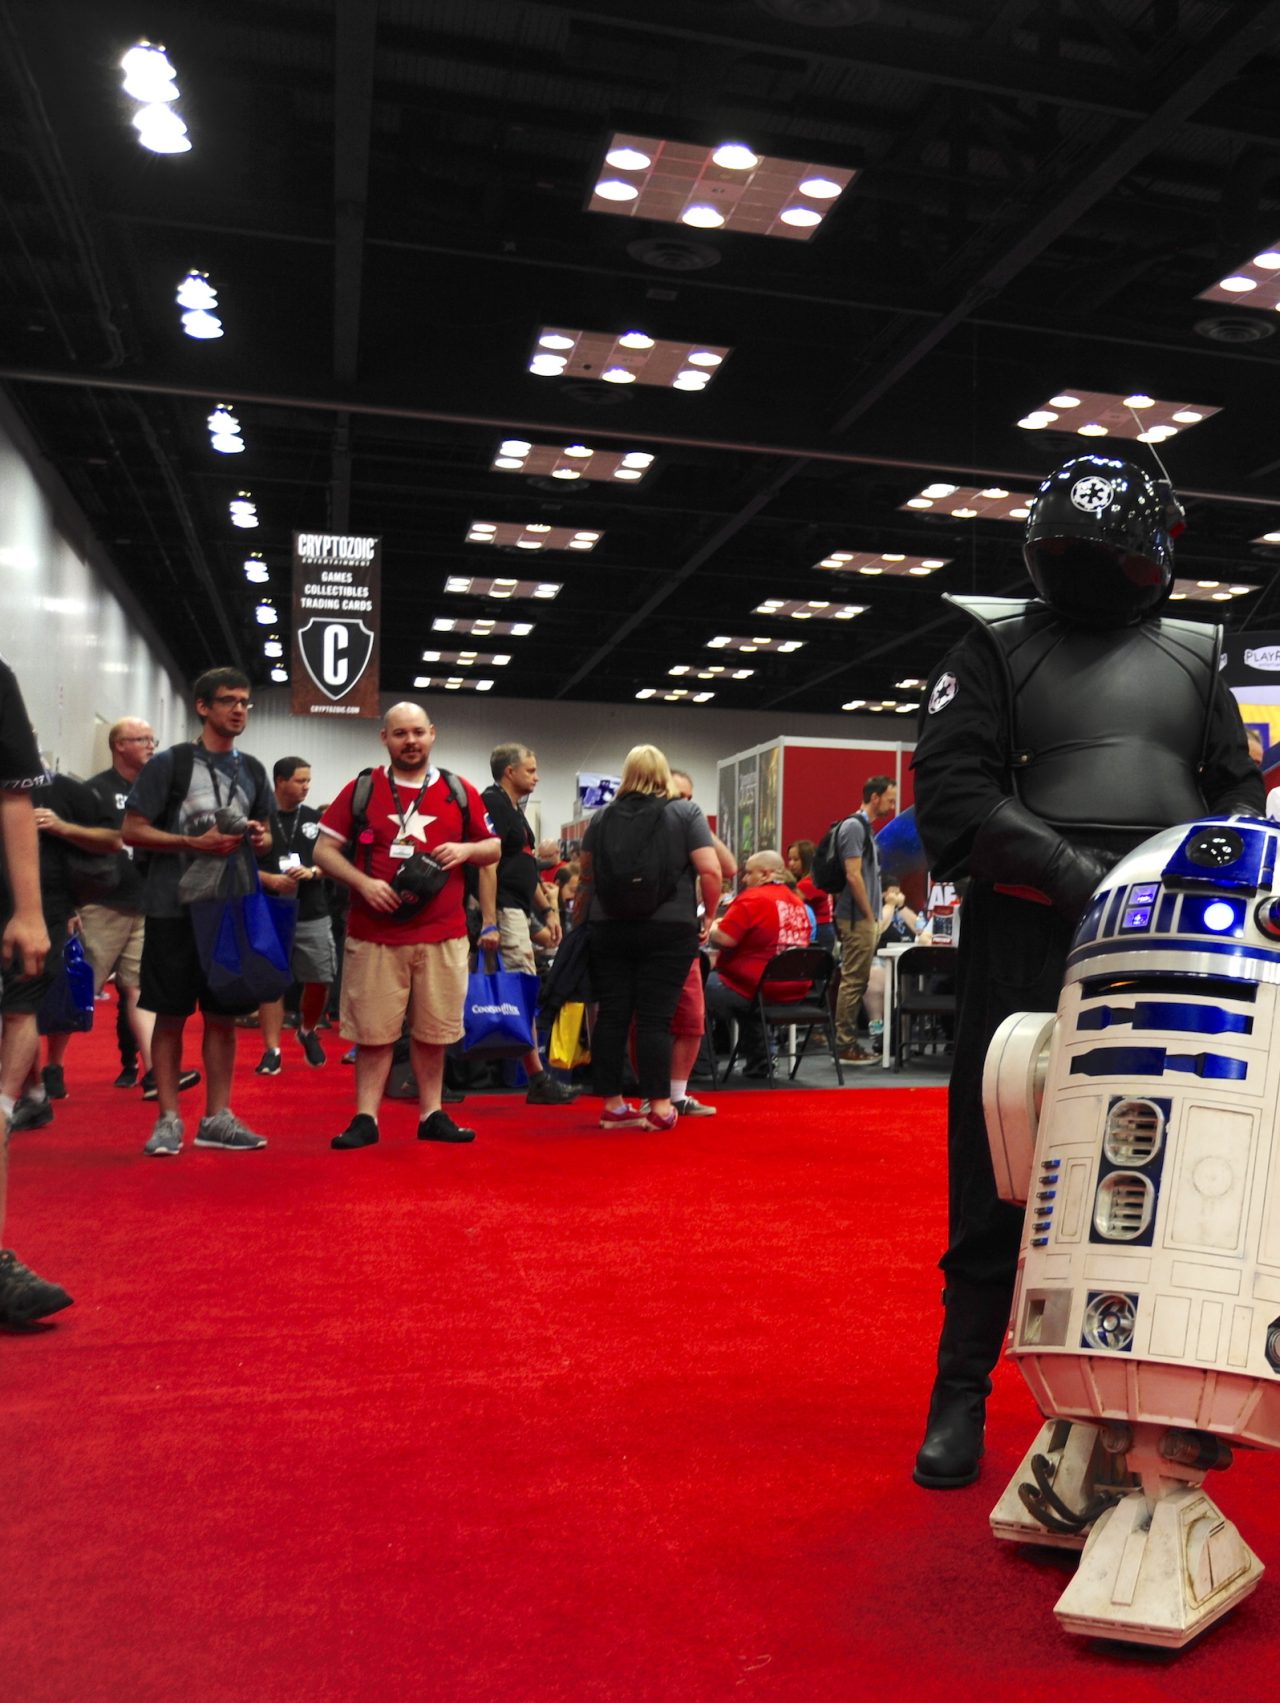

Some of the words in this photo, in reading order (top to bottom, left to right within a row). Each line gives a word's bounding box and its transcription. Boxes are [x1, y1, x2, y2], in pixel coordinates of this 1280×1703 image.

[298, 533, 375, 561] CRYPTOZOIC
[321, 571, 353, 583] GAMES
[304, 584, 369, 598] COLLECTIBLES
[301, 598, 339, 610] TRADING
[341, 599, 372, 611] CARDS
[323, 624, 349, 686] C
